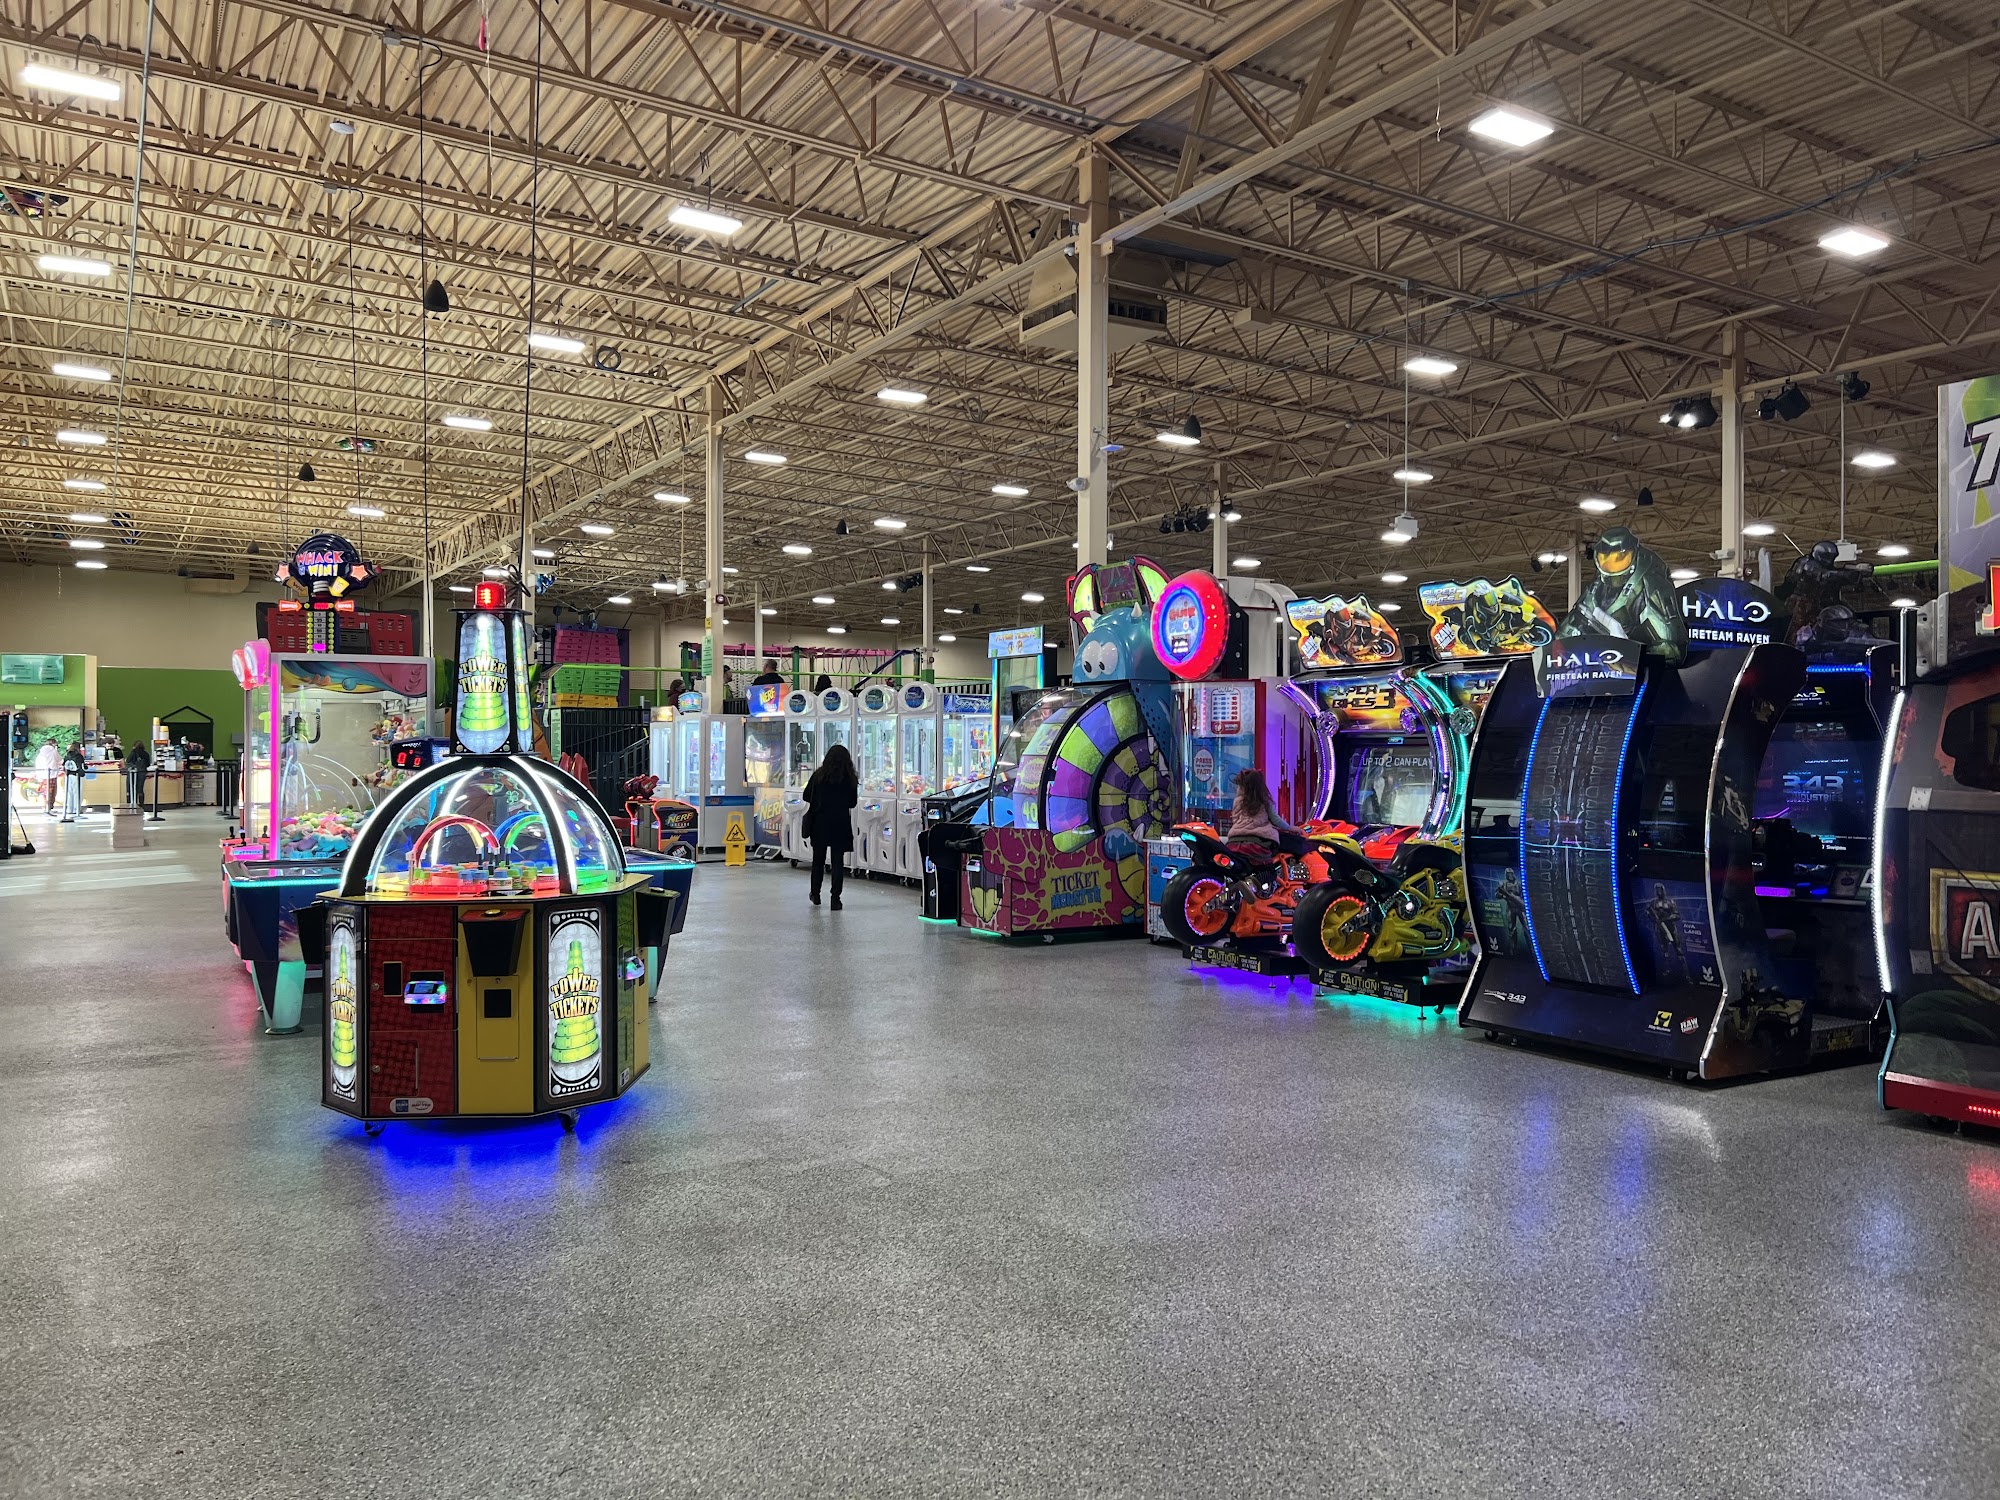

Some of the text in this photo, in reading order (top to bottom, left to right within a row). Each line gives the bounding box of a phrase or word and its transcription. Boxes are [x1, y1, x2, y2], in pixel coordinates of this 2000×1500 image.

[296, 550, 344, 565] WHACK
[308, 564, 338, 576] WIN!
[1422, 587, 1456, 598] SUPER
[1682, 595, 1771, 623] HALO
[1688, 628, 1771, 644] IRETEAM RAVEN
[459, 650, 506, 675] TOWER
[1546, 649, 1624, 668] HALO
[458, 674, 507, 693] TICKETS
[1546, 670, 1623, 681] FIRETEAM RAVEN
[760, 687, 776, 705] NERF
[1327, 684, 1396, 709] SUPER 3
[1332, 697, 1377, 709] BIKES
[1363, 756, 1432, 767] UP TO 2 CAN PLAY
[1782, 775, 1844, 793] 343
[667, 811, 694, 824] NERF
[1022, 801, 1038, 823] 40
[1051, 870, 1100, 892] TICKET
[1051, 888, 1101, 910] MONSTER
[1207, 950, 1239, 964] CAUTION!
[550, 967, 599, 998] TOWER
[1340, 975, 1380, 991] CAUTION!
[1507, 992, 1526, 1003] 343
[550, 995, 600, 1020] TICKETS
[1680, 1017, 1698, 1029] RAW
